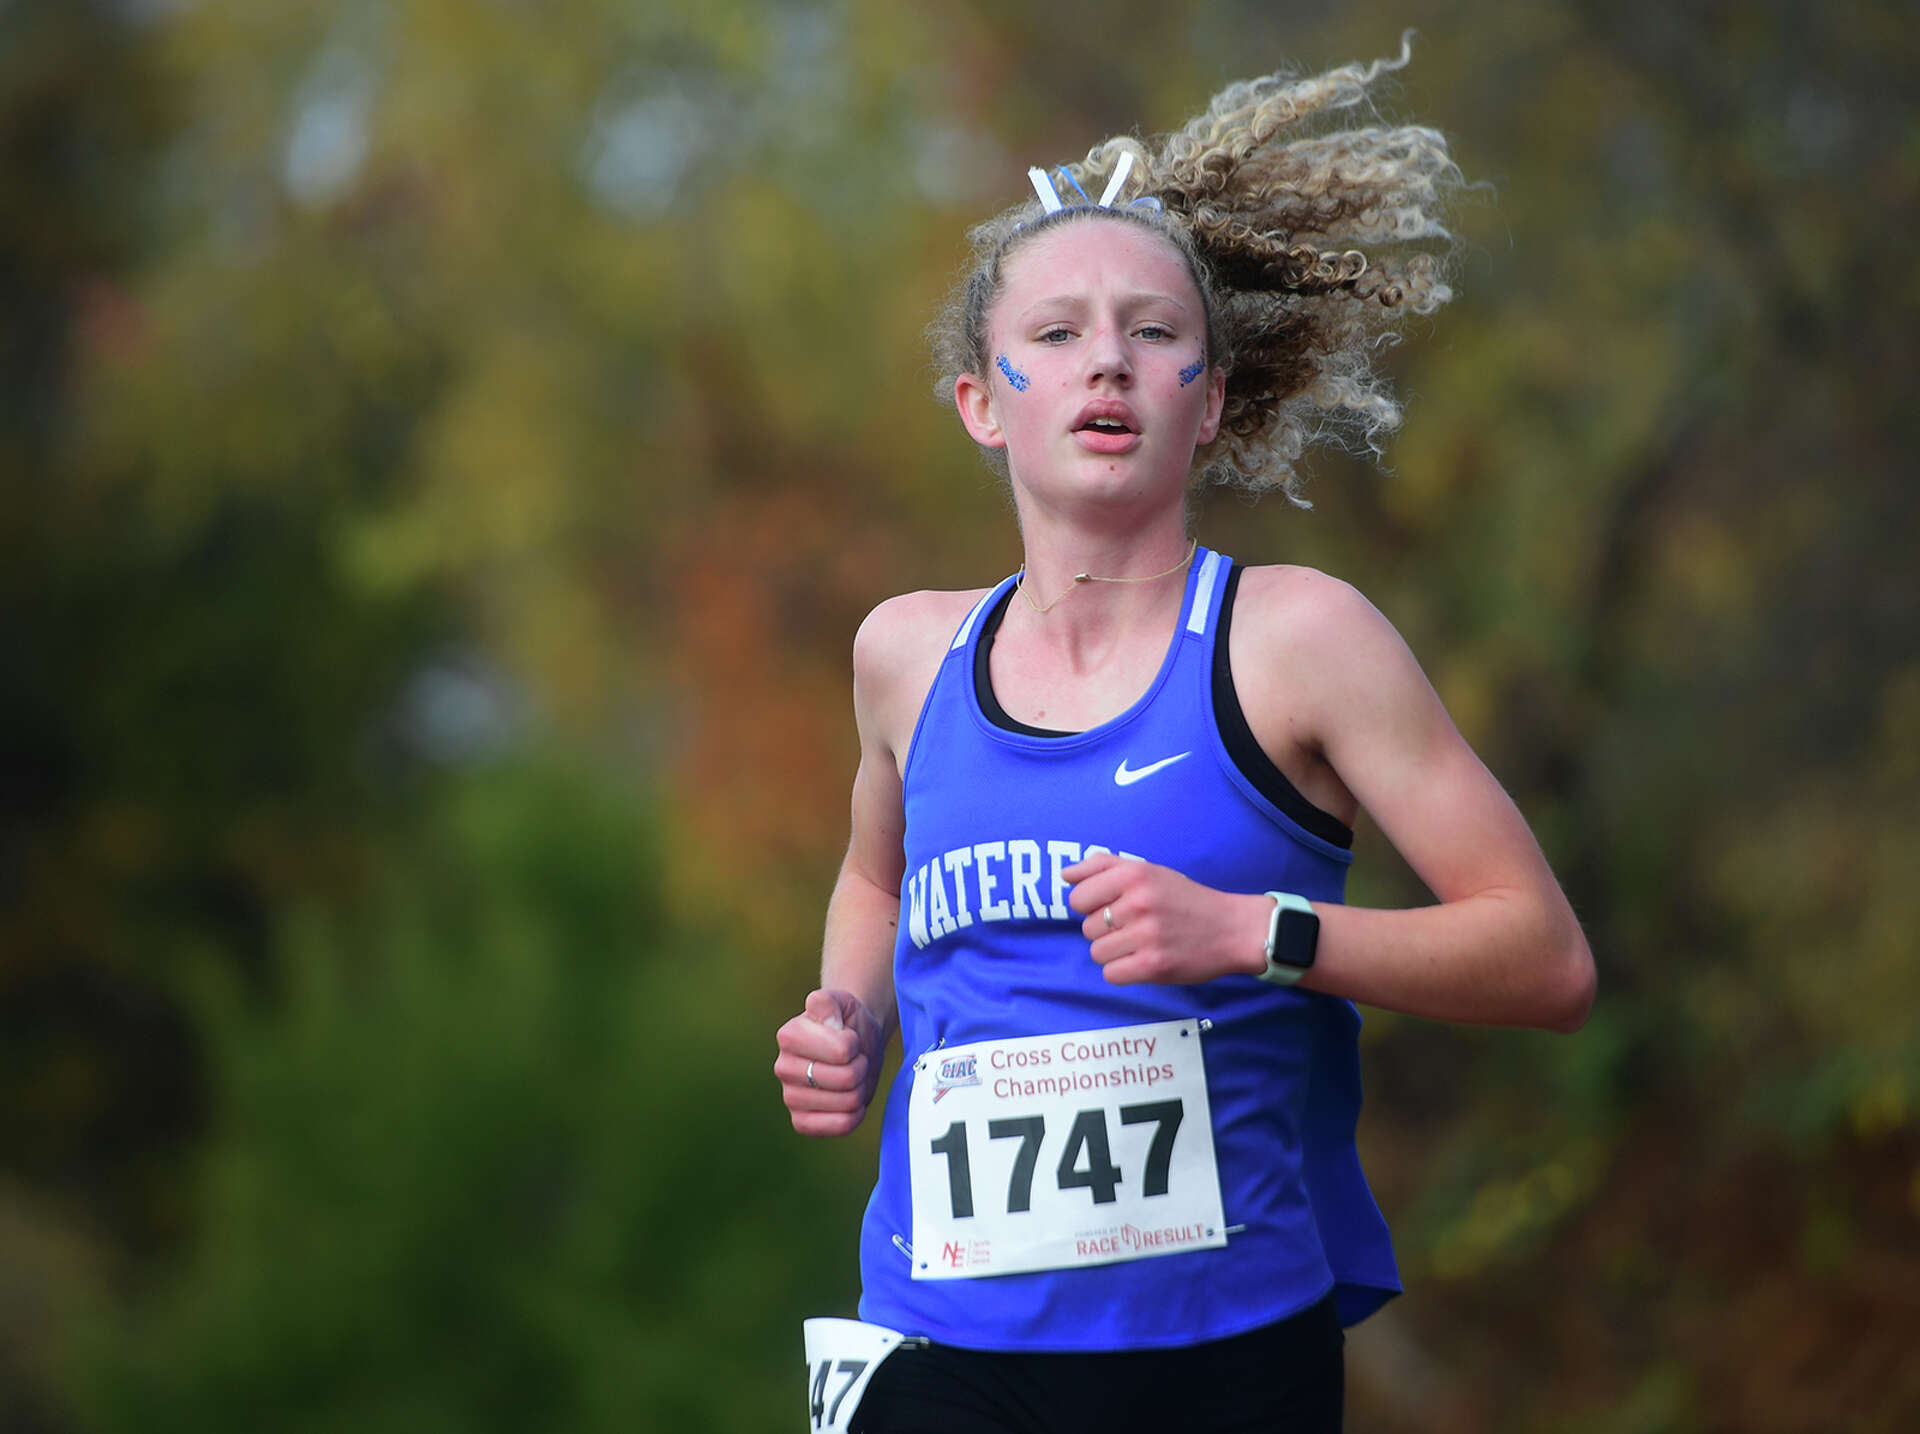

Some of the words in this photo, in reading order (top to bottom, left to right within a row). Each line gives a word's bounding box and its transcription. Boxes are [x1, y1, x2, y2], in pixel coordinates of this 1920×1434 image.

[907, 839, 1146, 950] WATERF
[991, 1049, 1051, 1070] Cross
[1061, 1036, 1157, 1063] Country
[994, 1061, 1174, 1099] Championships
[931, 1098, 1184, 1219] 1747
[1076, 1235, 1120, 1257] RACE
[1143, 1223, 1204, 1248] RESULT
